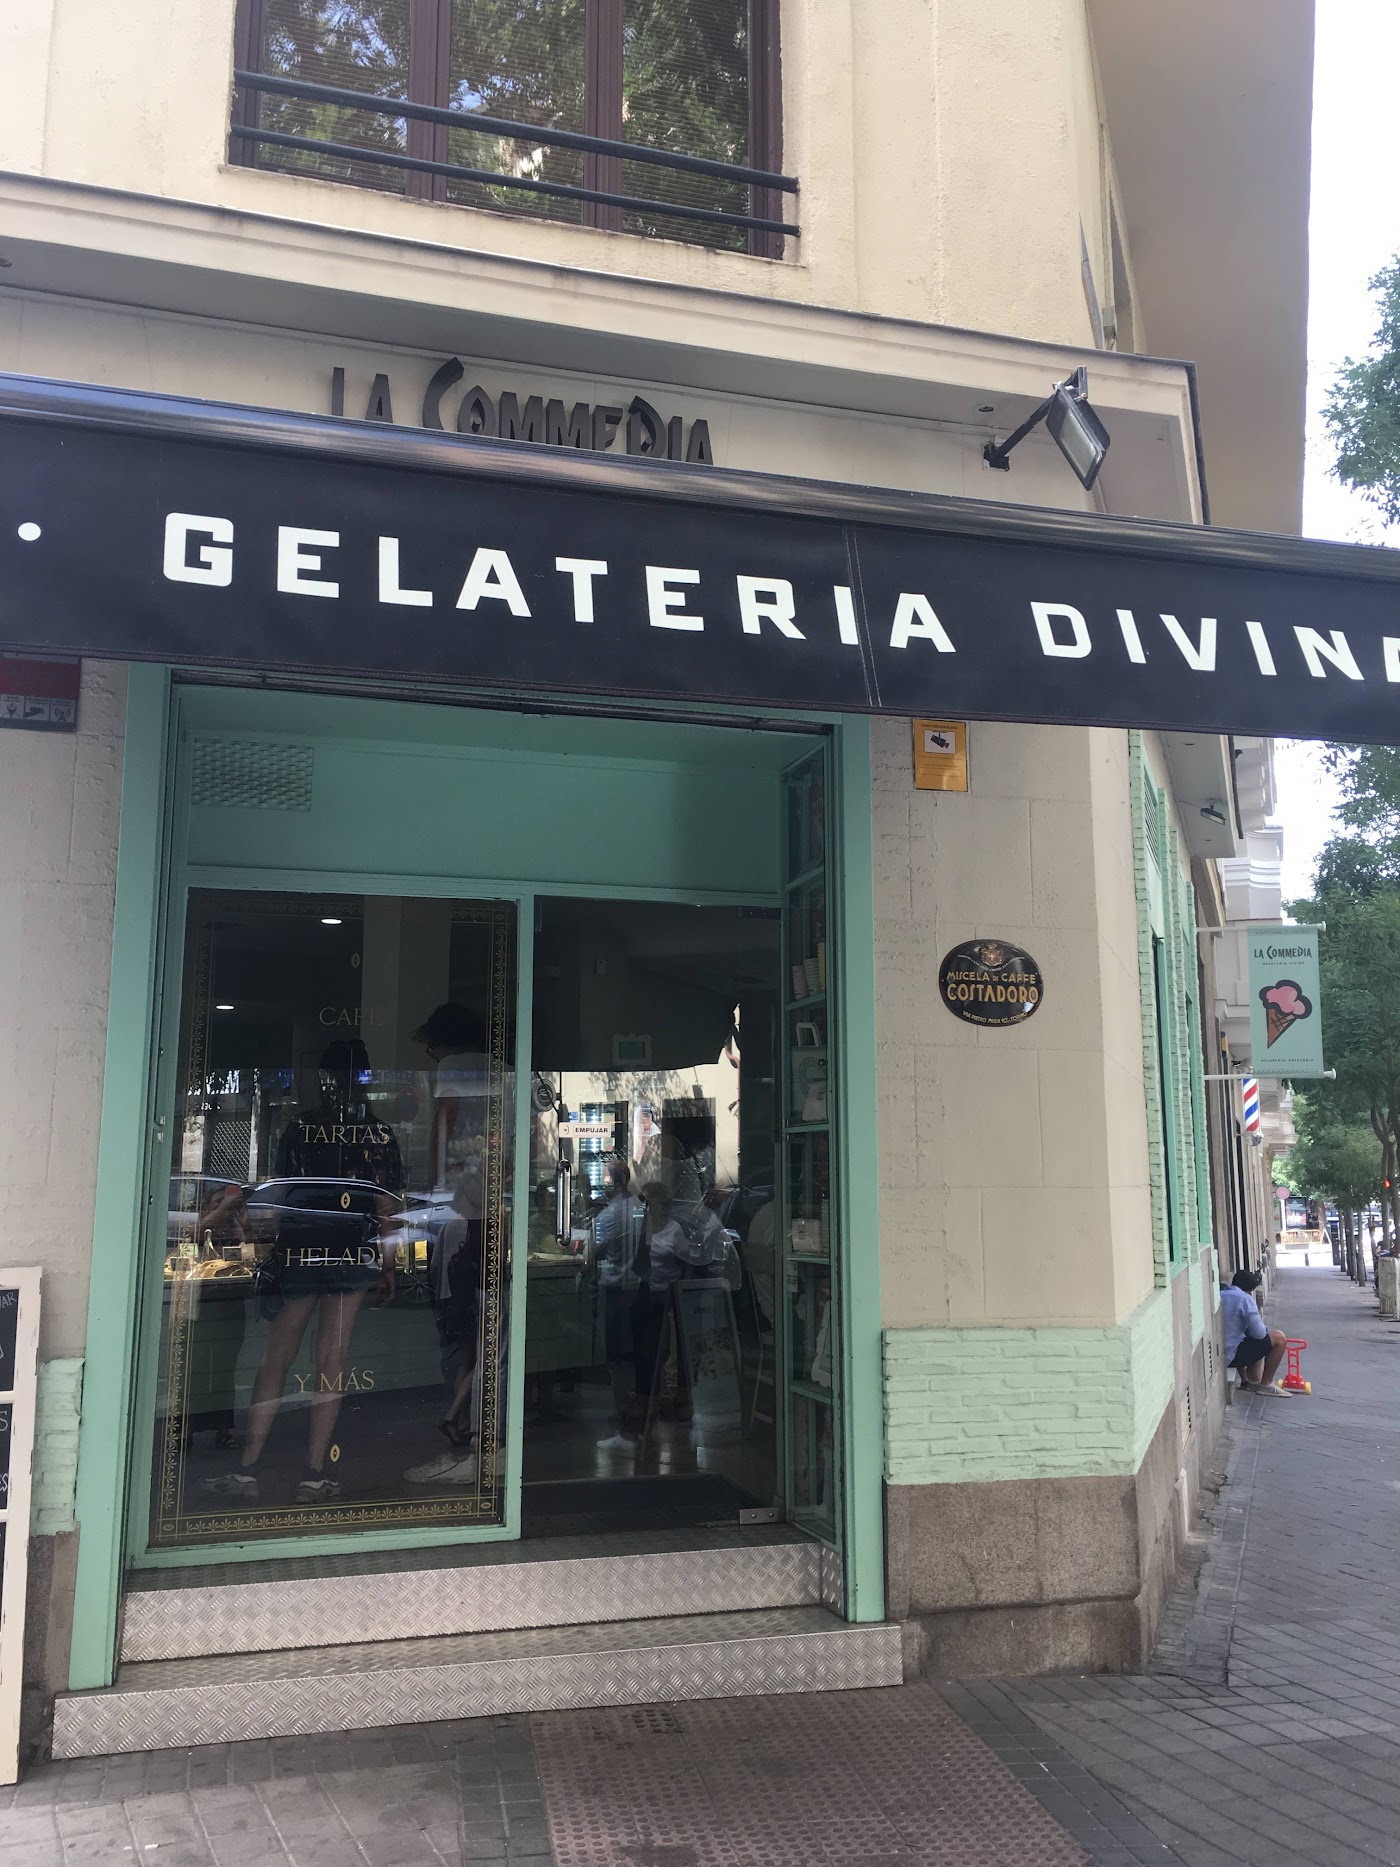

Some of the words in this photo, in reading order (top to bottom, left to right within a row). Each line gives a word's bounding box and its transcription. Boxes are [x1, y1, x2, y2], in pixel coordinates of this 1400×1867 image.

[163, 512, 956, 653] GELATERIA
[1254, 949, 1264, 959] LA
[1267, 945, 1312, 959] COMMEDIA
[946, 971, 990, 982] MISCELA
[947, 983, 1039, 1004] COSTADORO
[300, 1124, 390, 1144] TARTAS
[285, 1245, 409, 1267] HELADS
[293, 1373, 312, 1393] Y
[320, 1366, 375, 1392] MÁS
